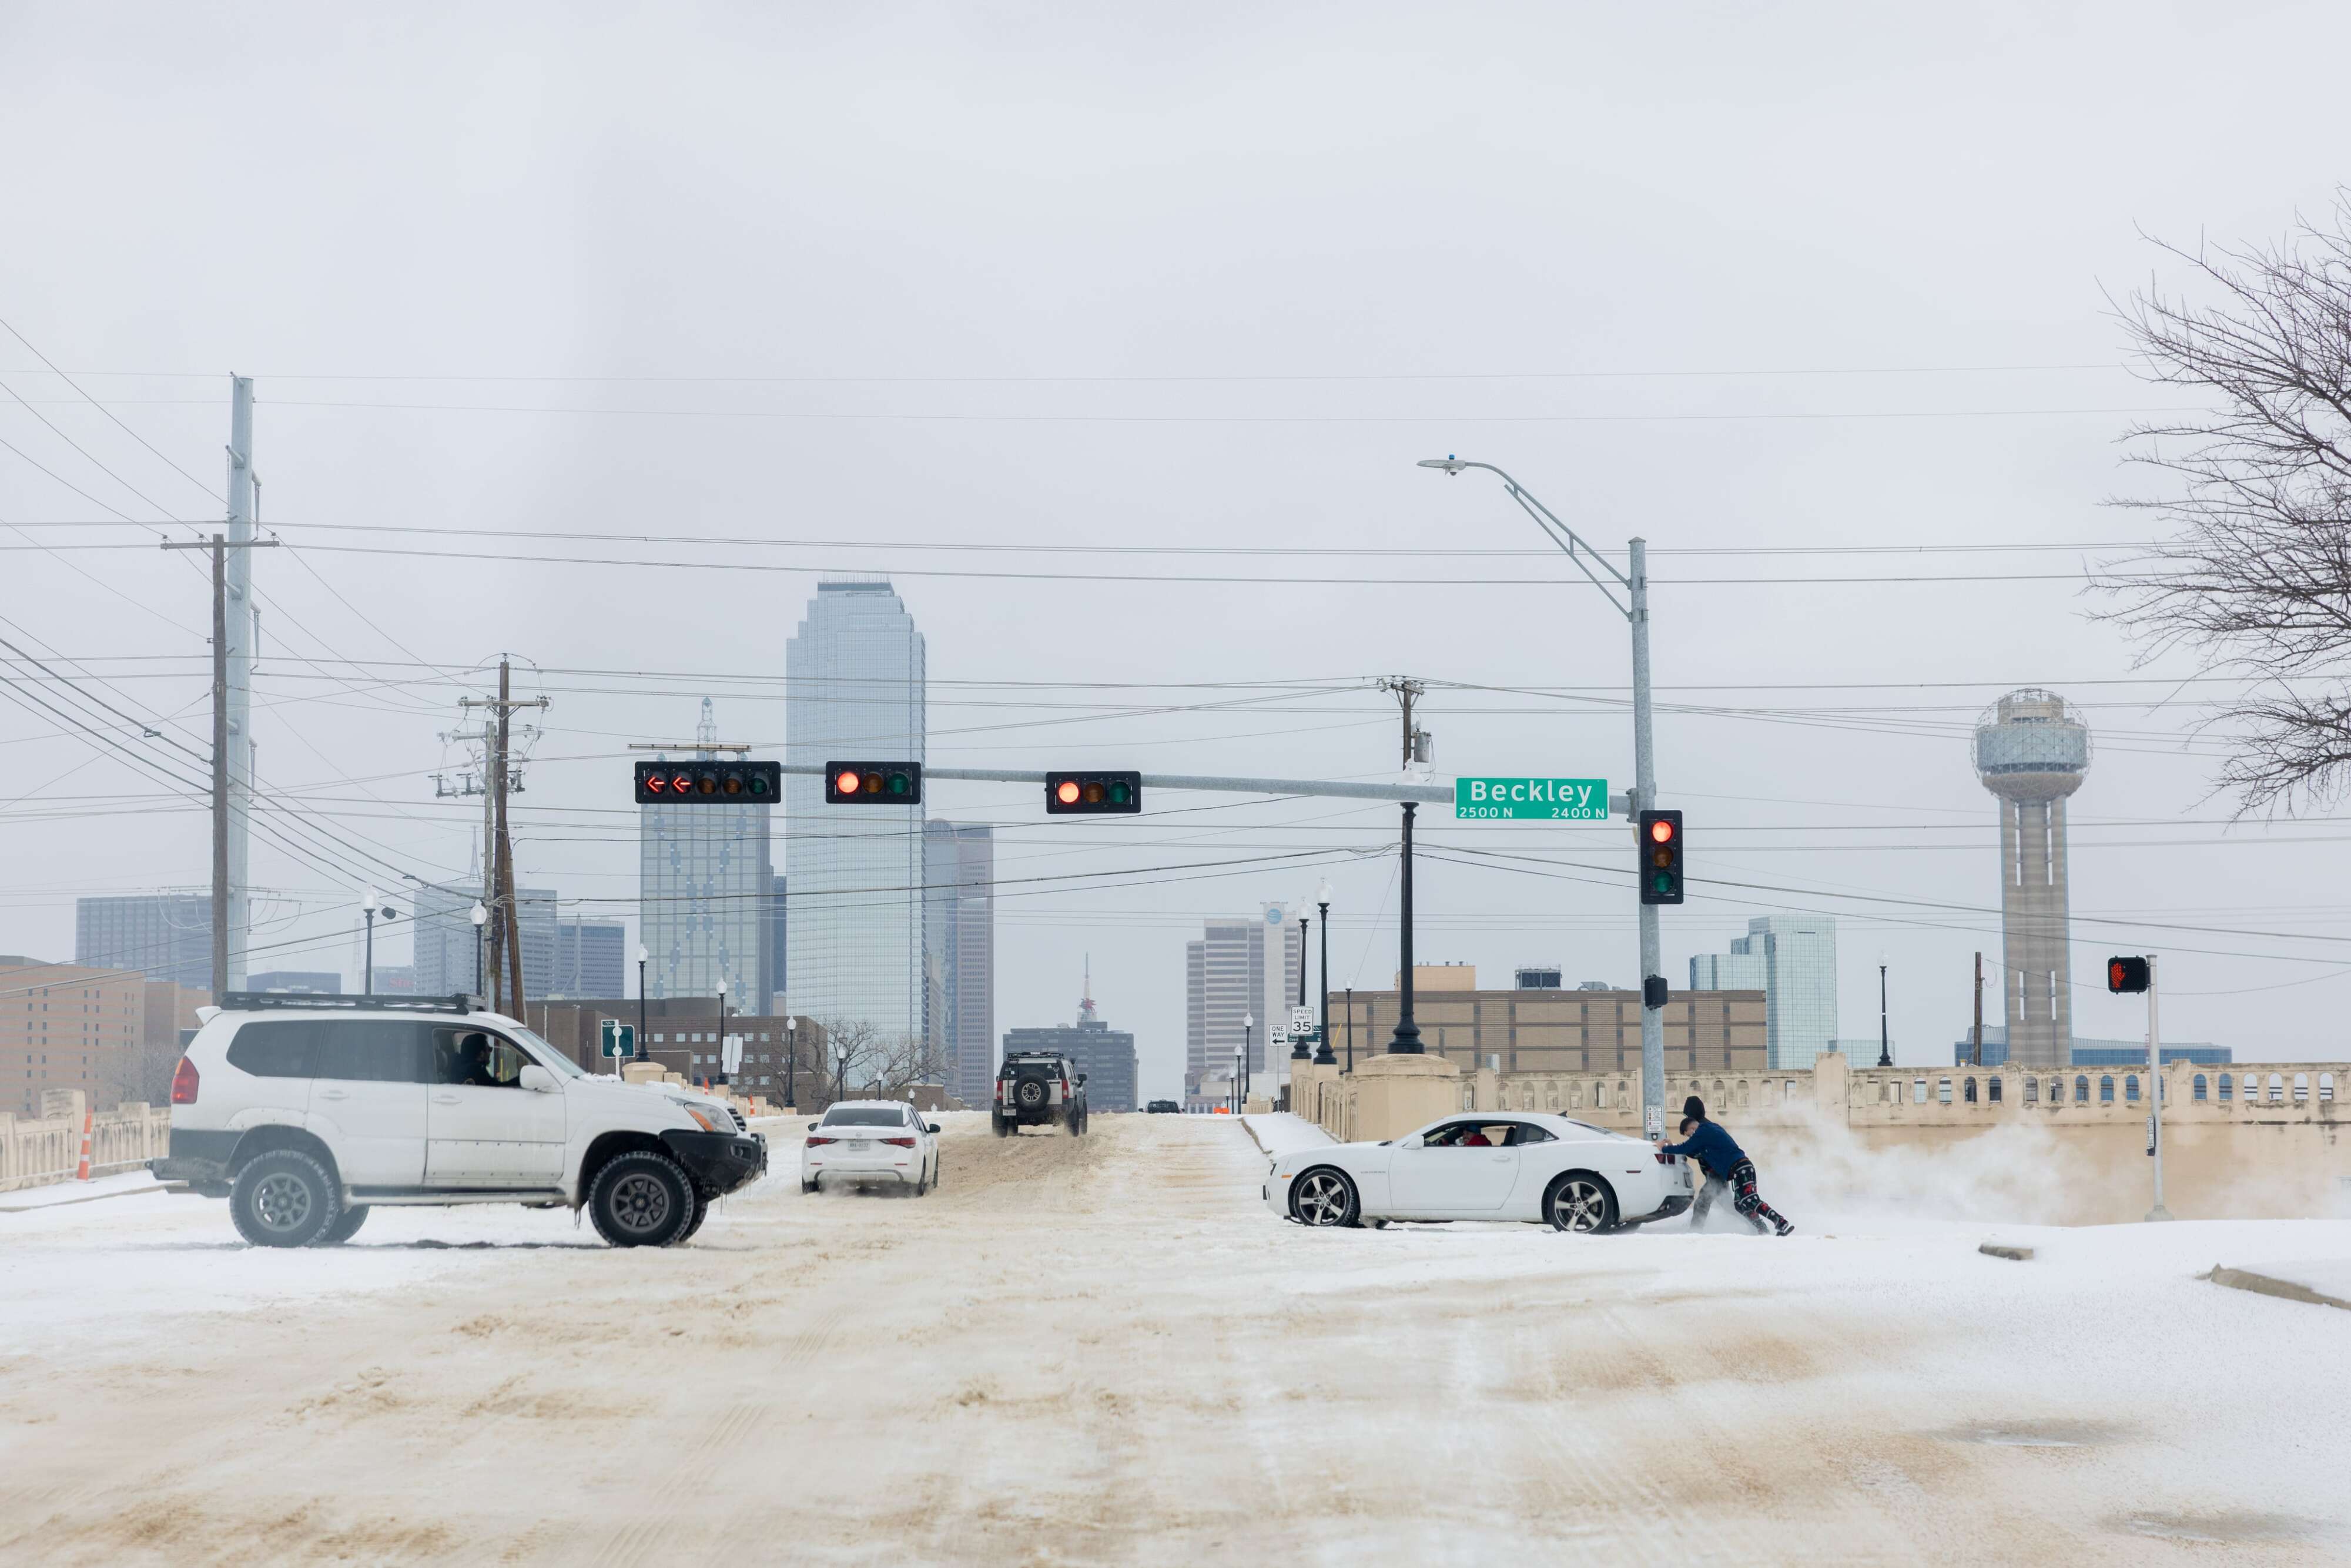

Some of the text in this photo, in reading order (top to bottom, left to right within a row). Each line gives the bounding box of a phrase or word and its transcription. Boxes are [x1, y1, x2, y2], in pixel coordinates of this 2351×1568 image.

[1471, 780, 1592, 808] Beckley
[1459, 807, 1513, 818] 2500 N
[1552, 808, 1605, 819] 2400 N
[1293, 1021, 1311, 1032] 35
